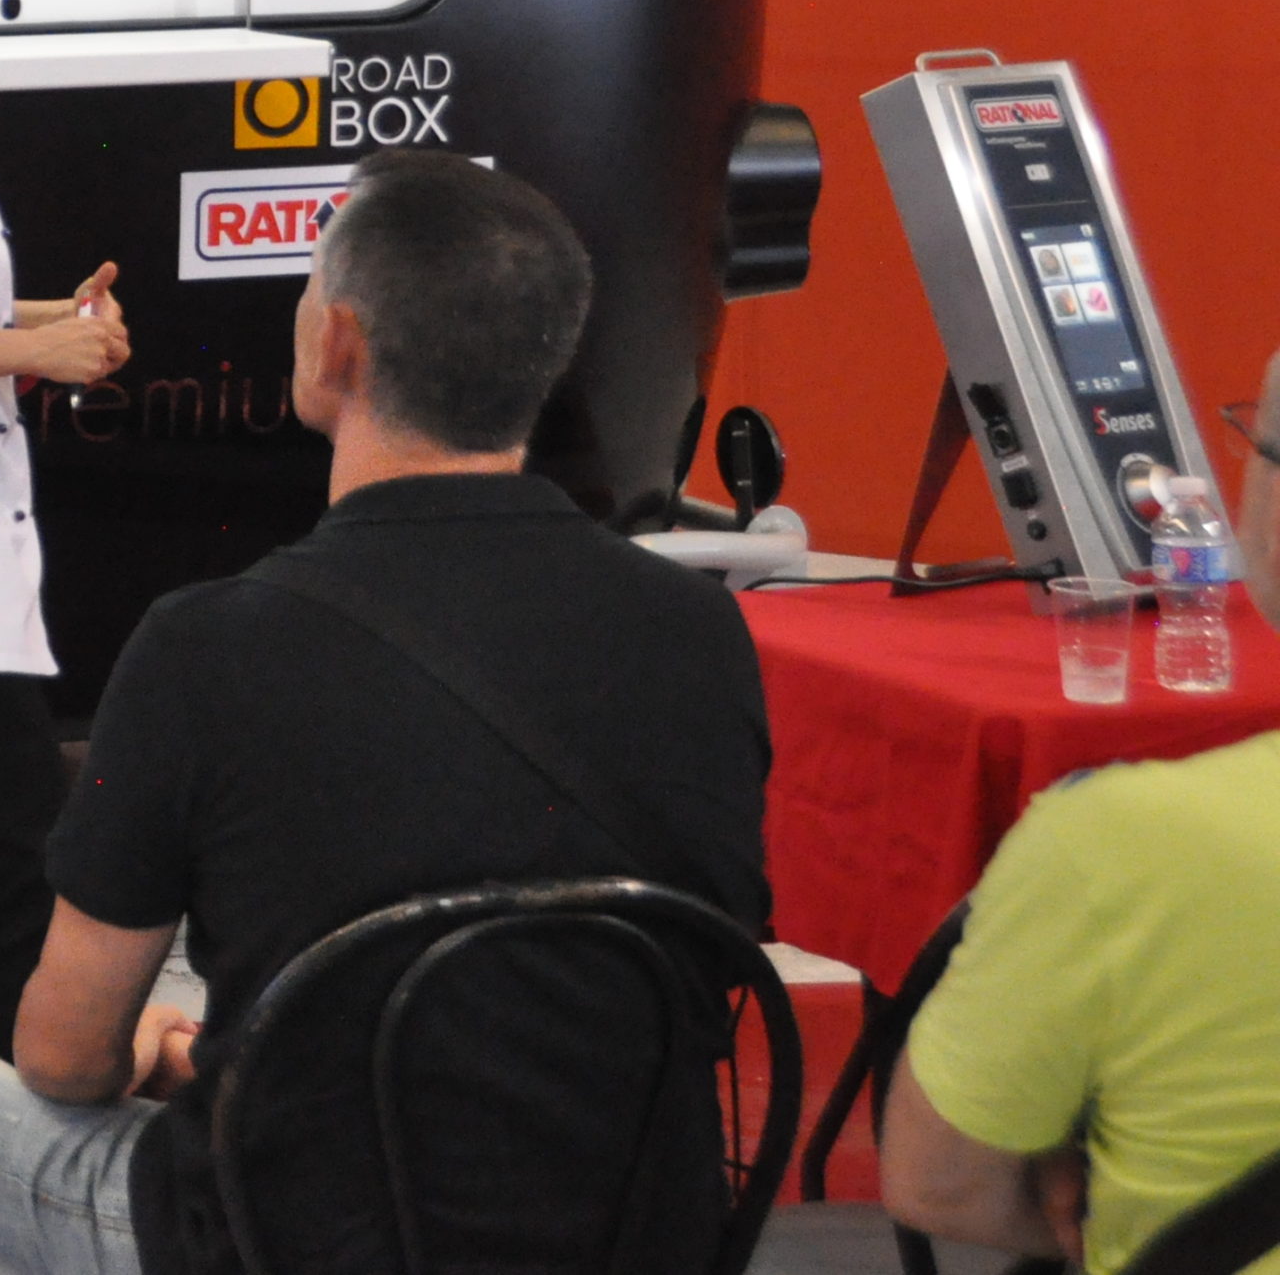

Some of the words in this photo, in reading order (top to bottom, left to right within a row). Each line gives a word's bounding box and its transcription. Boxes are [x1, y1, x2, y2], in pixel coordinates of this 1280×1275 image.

[331, 55, 452, 93] ROAD
[329, 95, 449, 147] BOX
[977, 102, 1058, 124] RATIONAL
[207, 192, 351, 247] RATI
[15, 360, 291, 444] remiu
